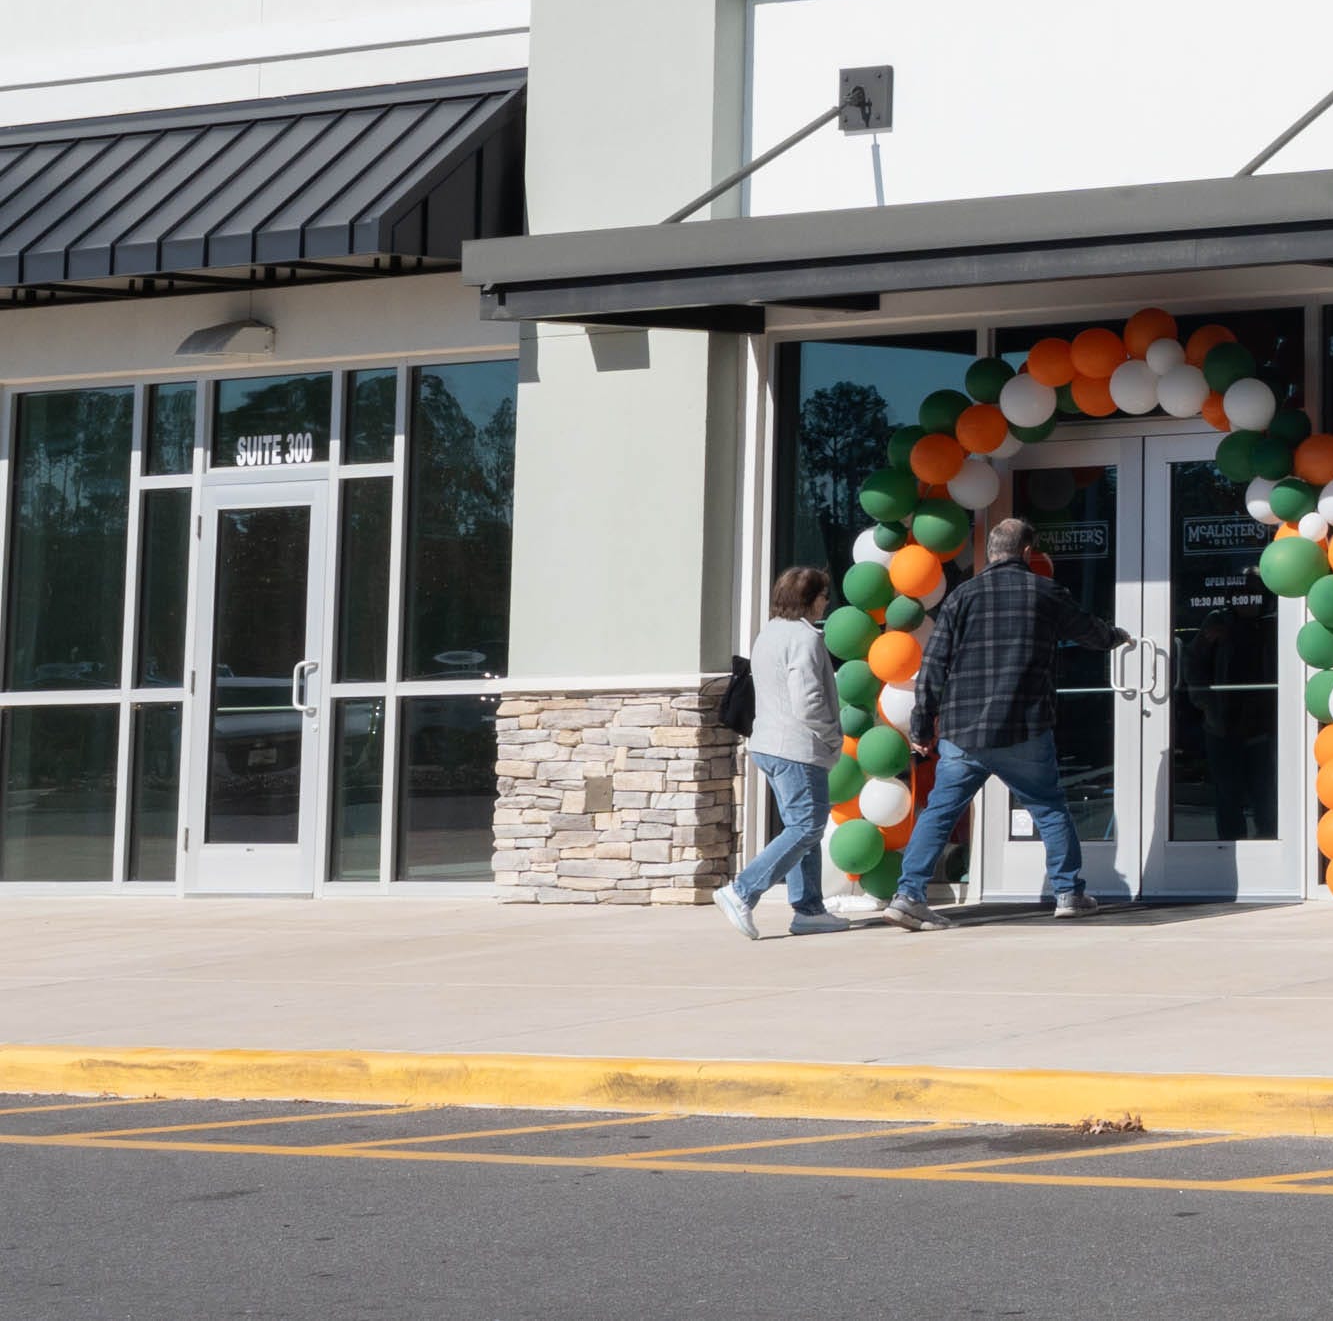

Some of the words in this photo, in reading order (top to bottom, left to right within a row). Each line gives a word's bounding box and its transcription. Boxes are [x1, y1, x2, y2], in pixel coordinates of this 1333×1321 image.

[236, 434, 282, 466] SUITE
[285, 432, 313, 464] 300
[1204, 577, 1225, 587] OPEN
[1226, 576, 1248, 586] DAILY
[1190, 597, 1212, 607] 10:30
[1212, 596, 1225, 607] AM
[1232, 596, 1249, 605] 9:00
[1250, 595, 1263, 605] PM
